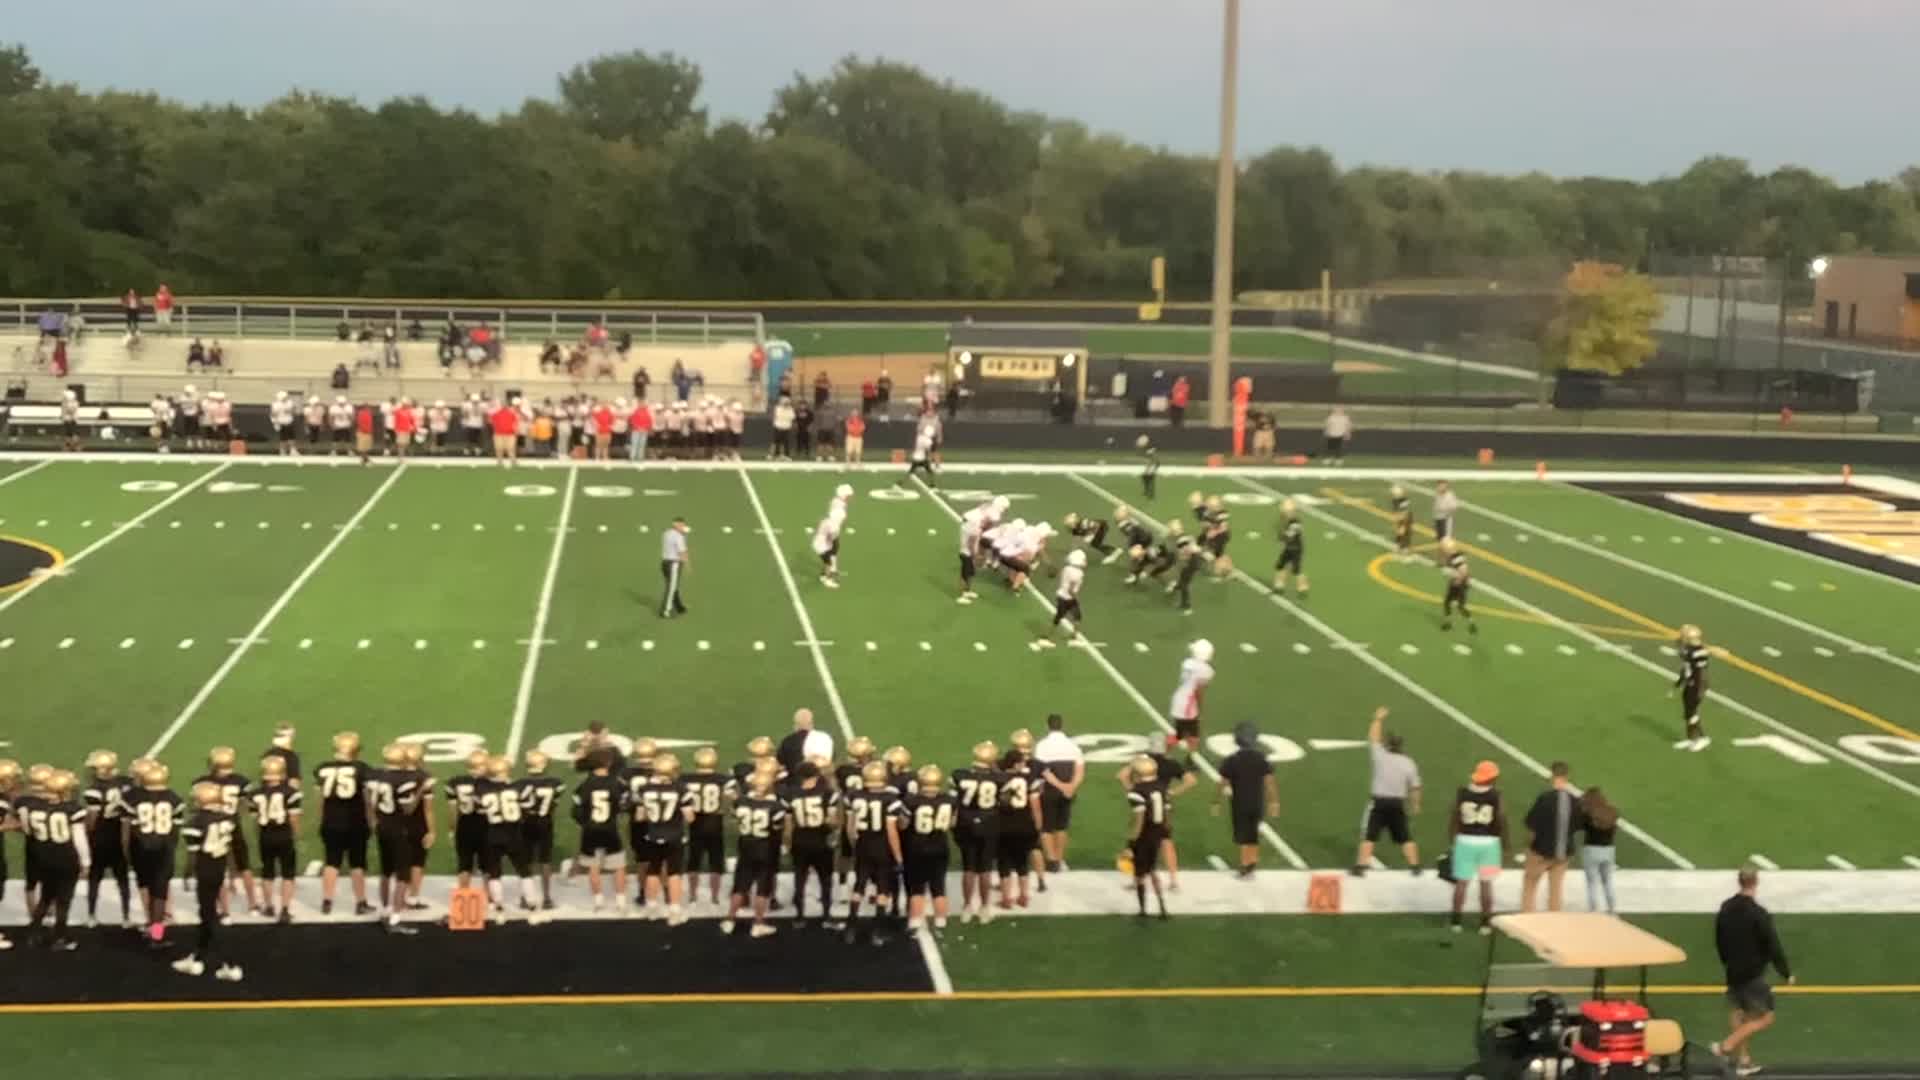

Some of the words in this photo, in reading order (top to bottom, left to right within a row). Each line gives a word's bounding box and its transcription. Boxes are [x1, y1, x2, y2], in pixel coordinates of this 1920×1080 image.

[396, 732, 634, 762] 30
[319, 766, 358, 798] 75
[960, 779, 998, 809] 78
[137, 801, 172, 835] 98
[253, 793, 286, 826] 14
[482, 790, 521, 824] 26
[592, 791, 611, 823] 5
[643, 791, 678, 823] 57
[736, 805, 769, 838] 32
[791, 796, 825, 828] 15
[852, 798, 883, 832] 21
[915, 803, 951, 834] 64
[30, 811, 70, 844] 50
